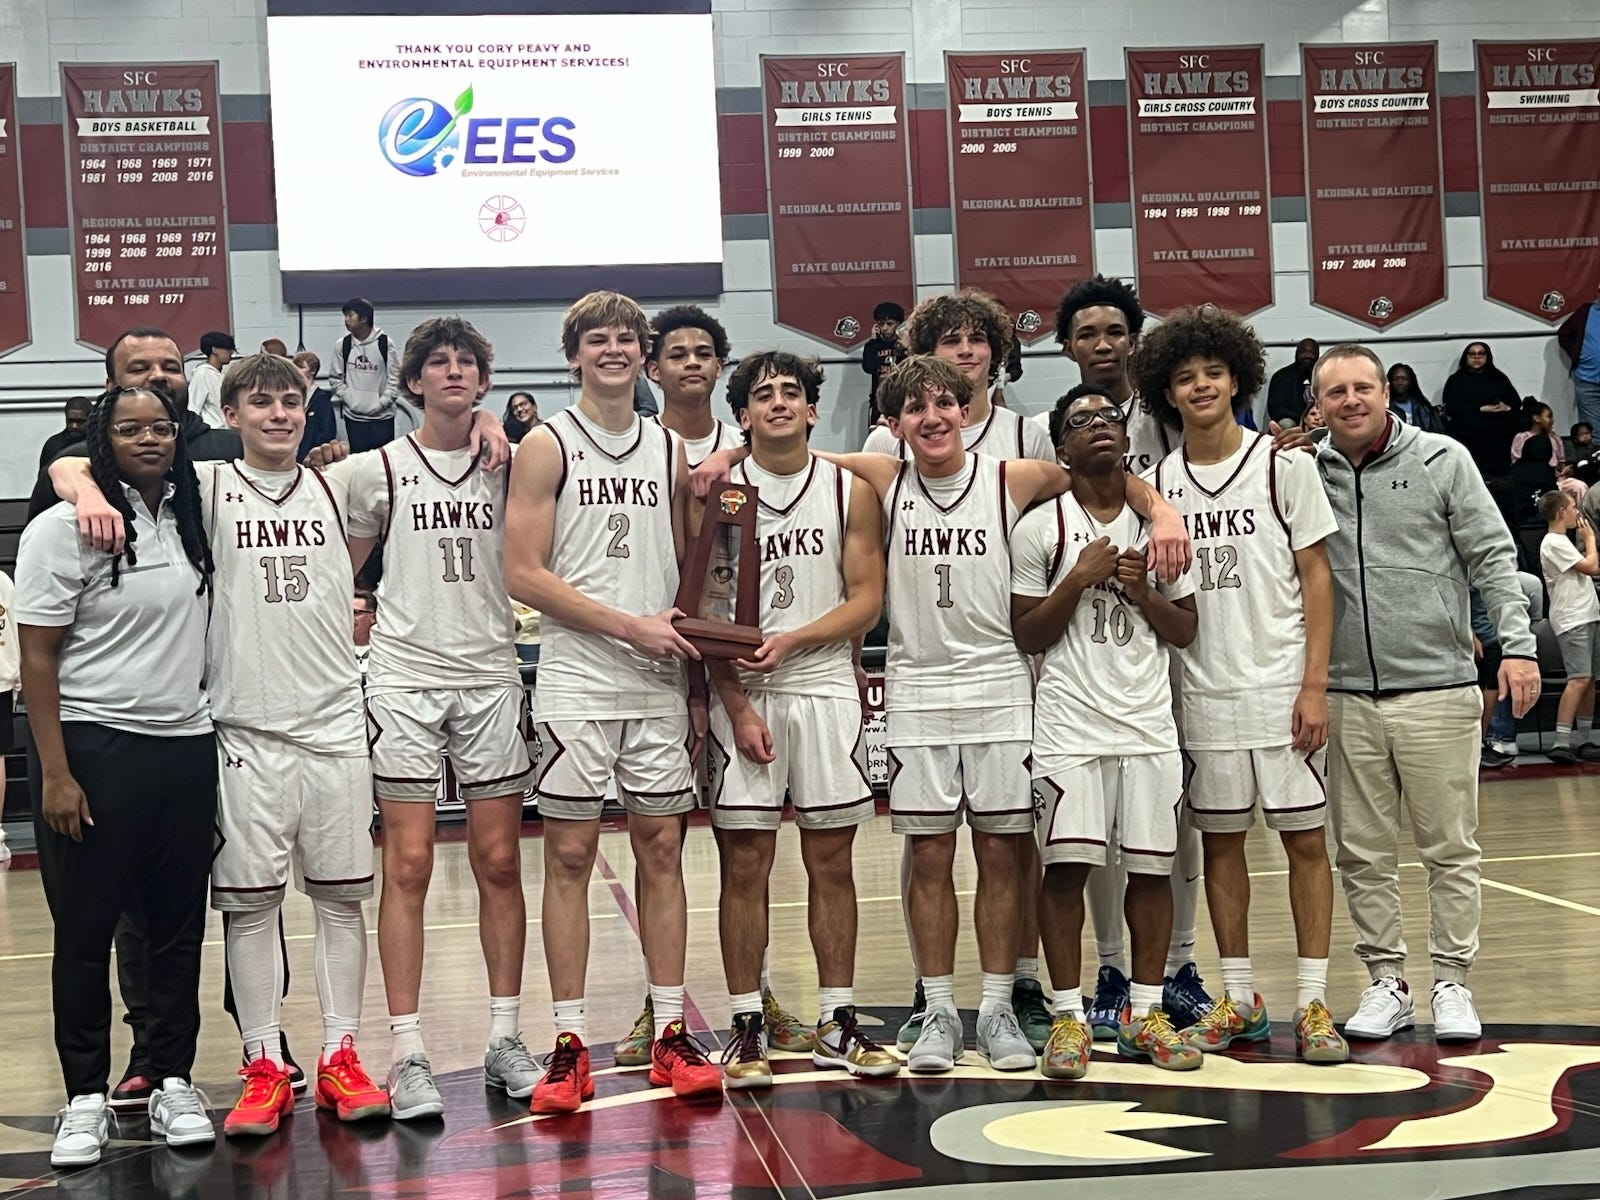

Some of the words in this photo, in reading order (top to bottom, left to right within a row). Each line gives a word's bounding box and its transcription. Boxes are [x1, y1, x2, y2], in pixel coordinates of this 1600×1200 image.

[396, 45, 441, 54] THANK
[446, 44, 473, 53] YOU
[478, 44, 513, 53] CORY
[518, 44, 559, 52] PEAVY
[565, 43, 591, 52] AND
[1528, 48, 1556, 61] SFC
[359, 59, 474, 69] ENVIRONMENTAL
[479, 58, 557, 69] EQUIPMENT
[1180, 55, 1209, 68] SFC
[1355, 51, 1384, 65] SFC
[818, 63, 848, 77] SFC
[1001, 59, 1031, 73] SFC
[124, 72, 157, 86] SFC
[1320, 68, 1423, 91] HAWKS
[1493, 64, 1594, 86] HAWKS
[964, 75, 1071, 100] HAWKS
[1144, 71, 1248, 95] HAWKS
[781, 79, 889, 103] HAWKS
[83, 89, 202, 112] HAWKS
[1320, 98, 1345, 109] BOYS
[1348, 98, 1378, 108] CROSS
[1382, 97, 1424, 107] COUNTRY
[1520, 94, 1569, 104] SWIMMING
[987, 108, 1012, 118] BOYS
[1016, 106, 1052, 117] TENNIS
[1144, 103, 1170, 113] GIRLS
[1174, 102, 1205, 112] CROSS
[1209, 101, 1251, 111] COUNTRY
[802, 112, 831, 122] GIRLS
[836, 111, 872, 121] TENNIS
[1317, 118, 1364, 128] DISTRICT
[1368, 116, 1428, 126] CHAMPIONS
[1490, 114, 1536, 124] DISTRICT
[1540, 112, 1599, 122] CHAMPIONS
[92, 122, 121, 132] BOYS
[126, 121, 196, 131] BASKETBALL
[961, 128, 1010, 138] DISTRICT
[1014, 126, 1077, 136] CHAMPIONS
[1141, 122, 1189, 132] DISTRICT
[1193, 121, 1254, 131] CHAMPIONS
[464, 117, 576, 164] EES
[778, 132, 827, 142] DISTRICT
[831, 130, 896, 140] CHAMPIONS
[80, 143, 134, 152] DISTRICT
[139, 142, 209, 152] CHAMPIONS
[778, 148, 801, 158] 1999
[810, 147, 834, 157] 2000
[961, 144, 984, 153] 2000
[993, 143, 1016, 152] 2005
[80, 159, 106, 169] 1964
[116, 159, 142, 169] 1968
[152, 158, 177, 168] 1969
[188, 158, 212, 168] 1971
[81, 173, 106, 183] 1981
[117, 173, 142, 183] 1999
[152, 172, 178, 182] 2008
[188, 172, 213, 182] 2016
[461, 169, 527, 178] Environmental
[530, 168, 578, 178] Equipment
[581, 167, 619, 176] Services
[1317, 188, 1369, 198] REGIONAL
[1373, 186, 1433, 196] QUALIFIERS
[1491, 183, 1541, 192] REGIONAL
[962, 199, 1016, 209] REGIONAL
[1020, 197, 1082, 207] QUALIFIERS
[1142, 193, 1194, 203] REGIONAL
[1198, 191, 1260, 201] QUALIFIERS
[779, 204, 834, 214] REGIONAL
[837, 202, 901, 212] QUALIFIERS
[1144, 208, 1167, 218] 1994
[1175, 207, 1198, 217] 1995
[1207, 207, 1230, 216] 1998
[1238, 205, 1261, 215] 1999
[82, 218, 142, 228] REGIONAL
[146, 216, 216, 227] QUALIFIERS
[84, 234, 110, 244] 1964
[120, 234, 146, 244] 1968
[156, 233, 182, 243] 1969
[192, 232, 216, 242] 1971
[1502, 240, 1536, 248] STATE
[1538, 238, 1598, 247] QUALIFIERS
[85, 248, 111, 258] 1999
[120, 248, 146, 257] 2006
[156, 247, 182, 257] 2008
[191, 246, 216, 256] 2011
[1154, 250, 1188, 259] STATE
[1192, 248, 1254, 258] QUALIFIERS
[1328, 245, 1363, 254] STATE
[1367, 243, 1427, 252] QUALIFIERS
[792, 262, 828, 272] STATE
[832, 261, 895, 271] QUALIFIERS
[975, 256, 1010, 266] STATE
[1014, 255, 1076, 265] QUALIFIERS
[1322, 260, 1344, 270] 1997
[1352, 259, 1376, 269] 2004
[85, 262, 112, 272] 2016
[96, 279, 134, 288] STATE
[138, 277, 209, 288] QUALIFIERS
[87, 295, 113, 305] 1964
[123, 294, 149, 304] 1968
[159, 294, 184, 304] 1971
[578, 478, 658, 507] HAWKS
[411, 501, 493, 531] HAWKS
[236, 520, 325, 548] HAWKS
[607, 513, 630, 558] 2
[905, 528, 987, 556] HAWKS
[438, 537, 475, 582] 11
[1197, 545, 1241, 591] 12
[260, 555, 309, 603] 15
[770, 565, 794, 609] 3
[935, 564, 954, 608] 1
[1091, 598, 1134, 646] 10
